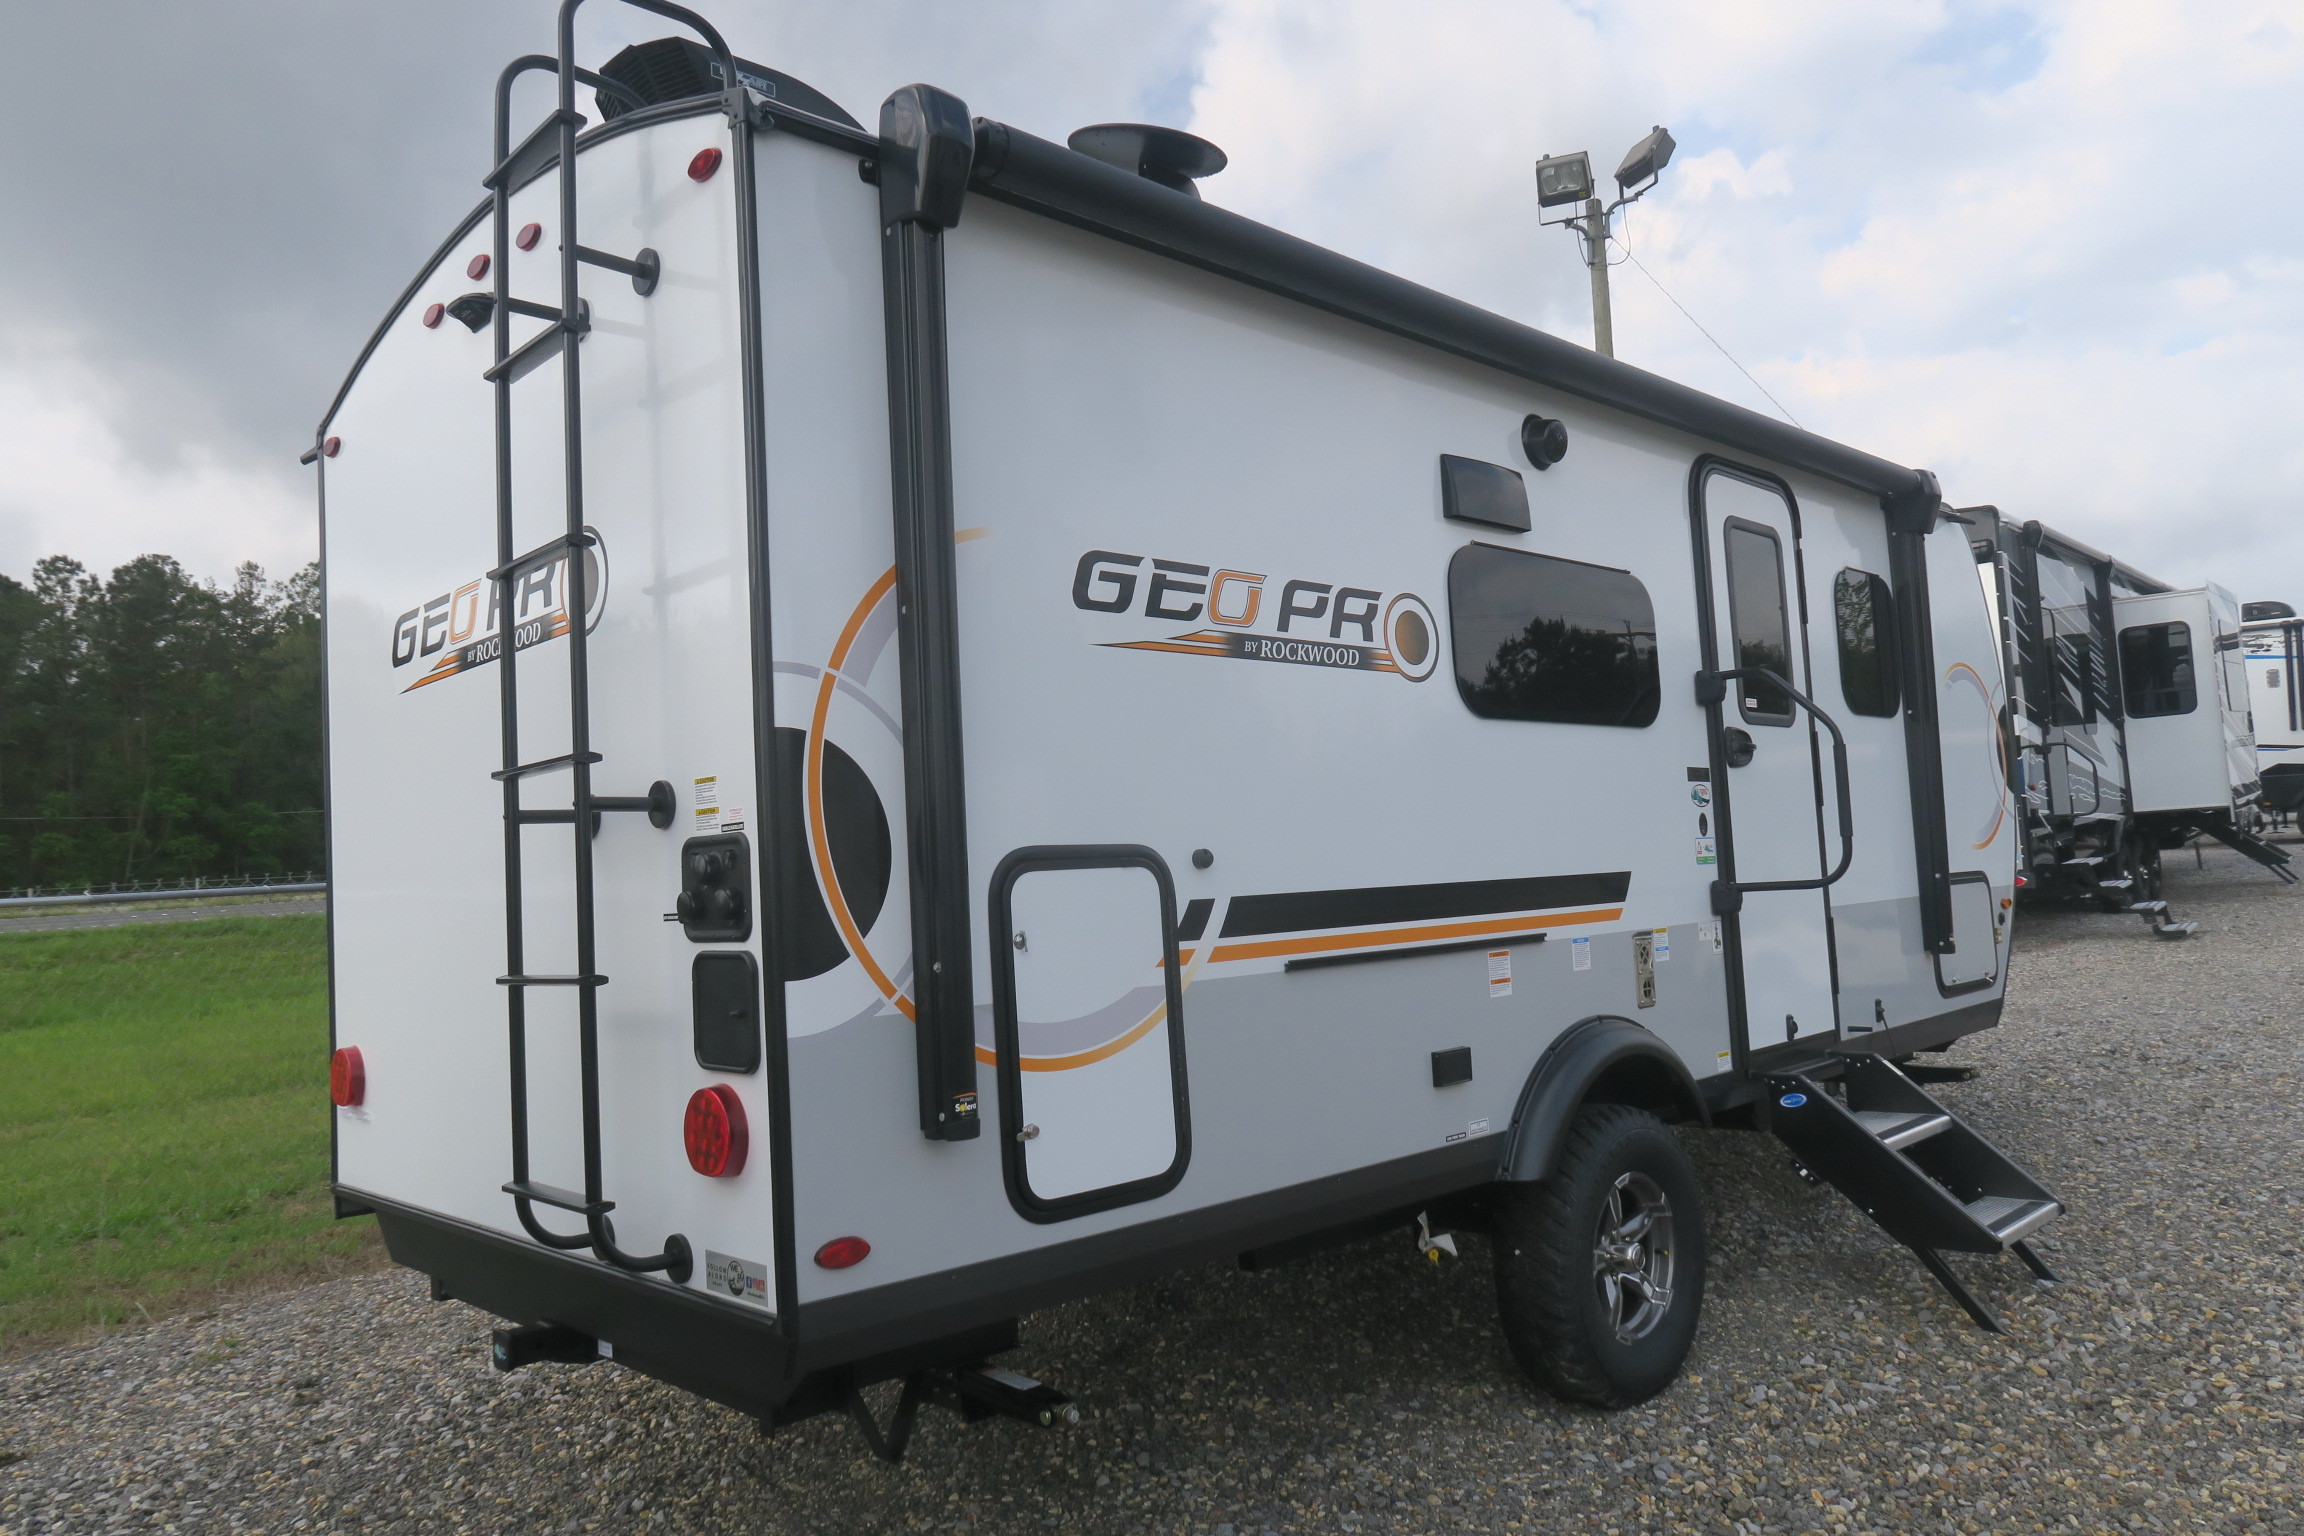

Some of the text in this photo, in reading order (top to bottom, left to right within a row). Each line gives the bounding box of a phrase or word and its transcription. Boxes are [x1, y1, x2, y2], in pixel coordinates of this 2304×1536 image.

[392, 577, 482, 668] GEO
[467, 622, 541, 663] BY ROCOOD
[1072, 550, 1439, 682] GEO PRO
[1244, 639, 1360, 666] BY ROCKWOOD
